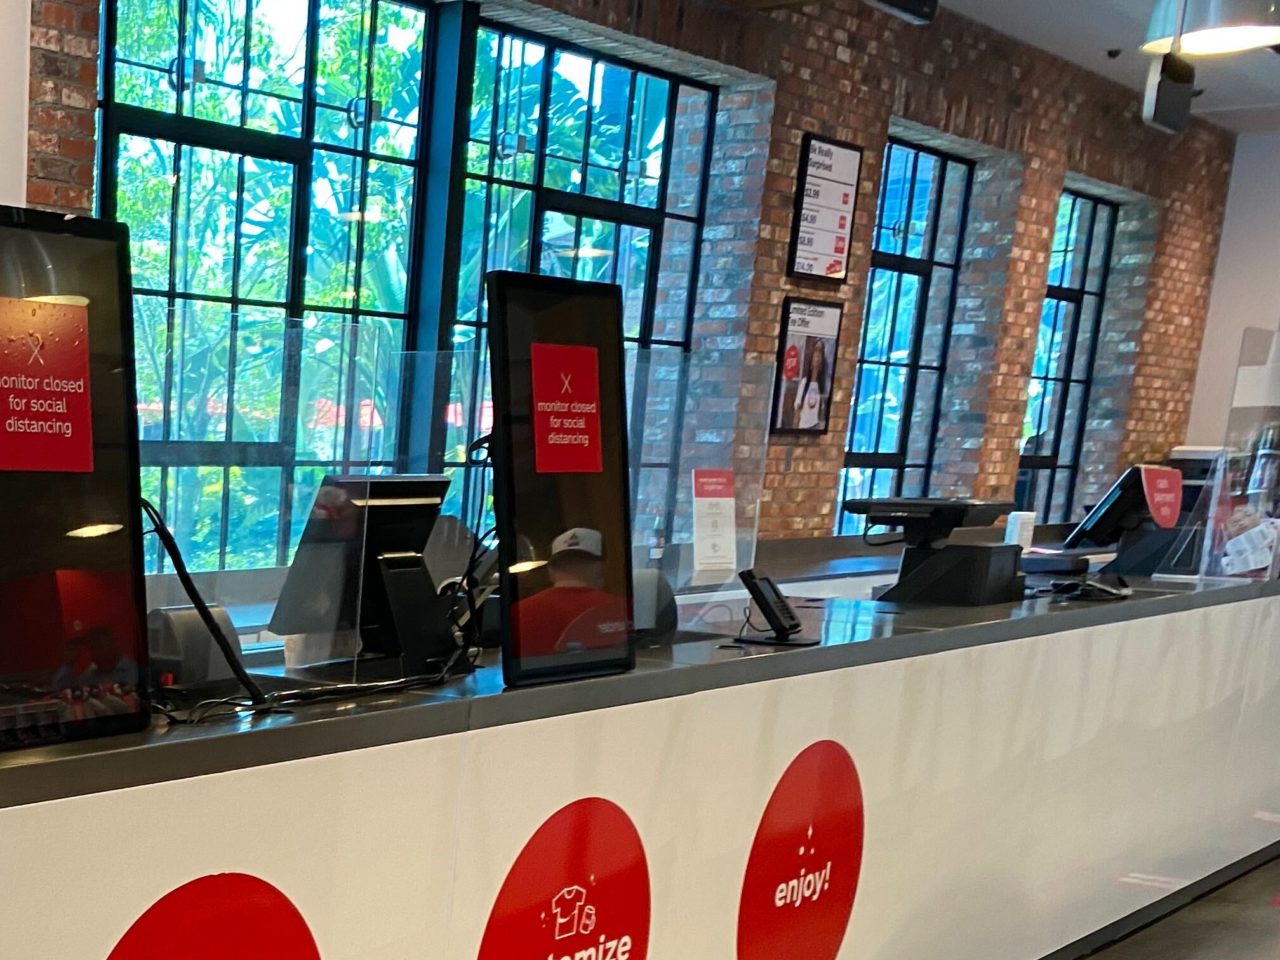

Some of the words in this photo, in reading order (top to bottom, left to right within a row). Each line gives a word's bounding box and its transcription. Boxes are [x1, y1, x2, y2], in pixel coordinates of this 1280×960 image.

[43, 376, 84, 393] closed
[9, 394, 26, 411] for
[31, 397, 67, 413] social
[538, 401, 569, 412] monitor
[571, 402, 596, 413] closed
[6, 417, 72, 437] distancing
[550, 416, 562, 428] for
[563, 417, 585, 428] social
[548, 432, 589, 447] distancing
[774, 861, 832, 908] enjoy!
